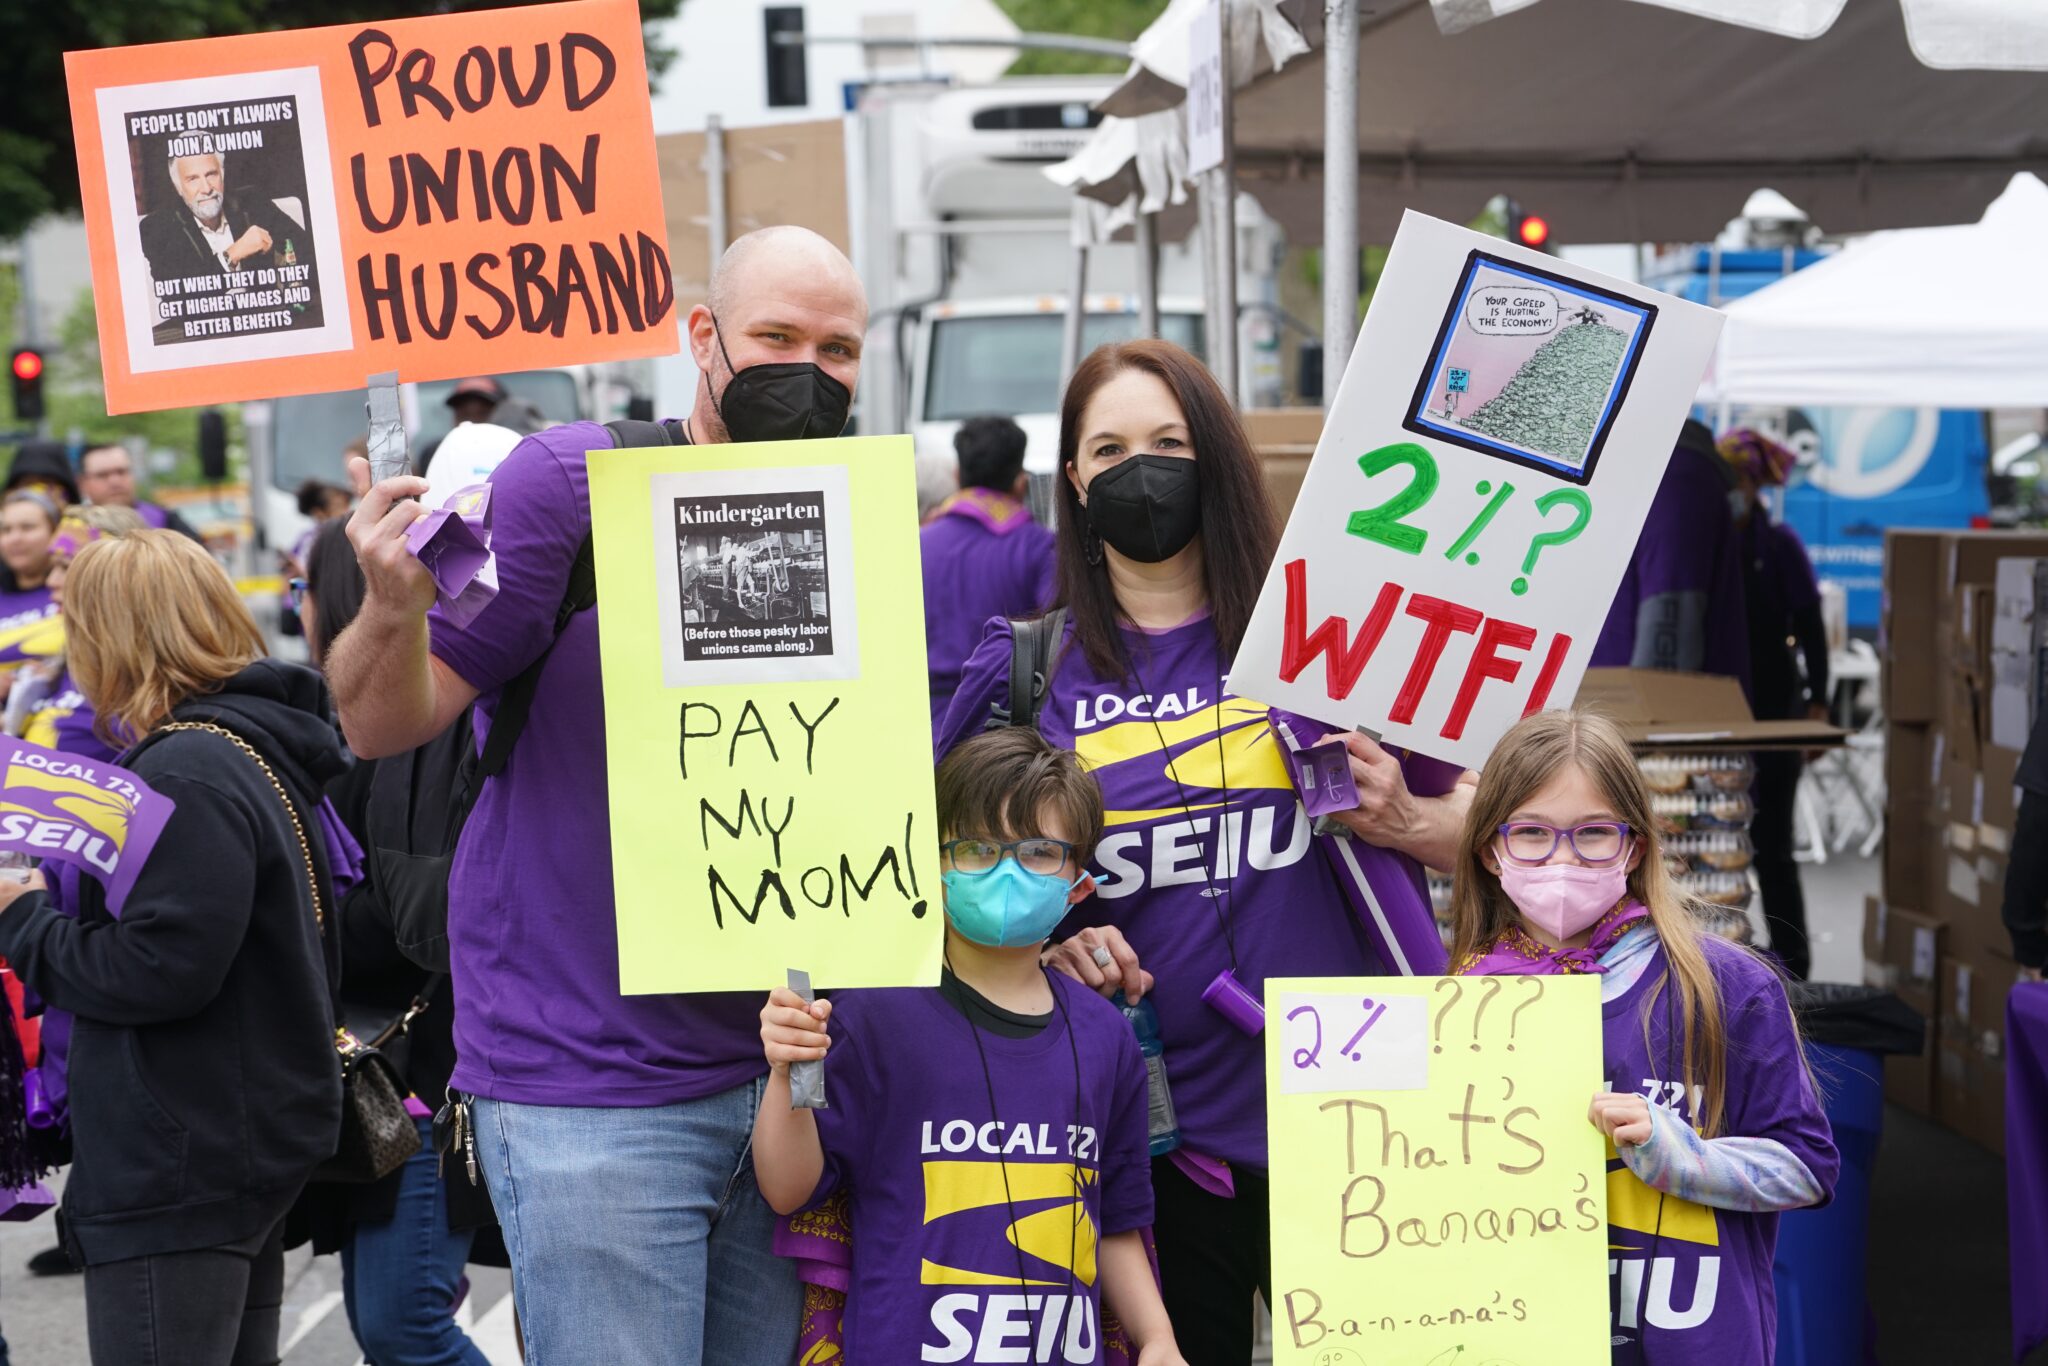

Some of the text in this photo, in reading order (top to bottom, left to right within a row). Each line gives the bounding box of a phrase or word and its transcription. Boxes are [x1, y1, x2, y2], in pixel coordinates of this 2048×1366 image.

[348, 29, 616, 126] PROUD
[131, 102, 293, 136] PEOPLE DON'T ALWAYS
[167, 130, 263, 158] JOIN A UNION
[351, 134, 600, 233] UNION
[155, 264, 309, 296] BUT WHEN THEY DO THEY
[358, 231, 673, 344] HUSBAND
[160, 286, 311, 318] GET HIGHER WAGES AND
[1478, 318, 1553, 327] THE ECONOMY!
[1485, 296, 1546, 308] YOUR GREED
[1490, 308, 1540, 316] IS HURTING
[184, 310, 292, 337] BETTER BENEFITS
[679, 502, 820, 527] Kindergarten
[684, 622, 829, 641] (Before those pesky labor
[701, 638, 815, 655] unions came along.)
[1074, 687, 1207, 729] LOCAL
[680, 697, 840, 780] PAY
[10, 750, 142, 806] LOCAL 721
[0, 814, 119, 875] SEIU
[700, 788, 794, 868] MY
[1094, 799, 1312, 899] SEIU
[708, 812, 928, 930] MOM!
[1286, 975, 1544, 1069] 2% ???
[1642, 1078, 1705, 1117] 721
[921, 1119, 1058, 1155] LOCAL
[1319, 1076, 1545, 1175] That's
[1340, 1173, 1599, 1259] Banana's
[921, 1293, 1097, 1365] SEIU
